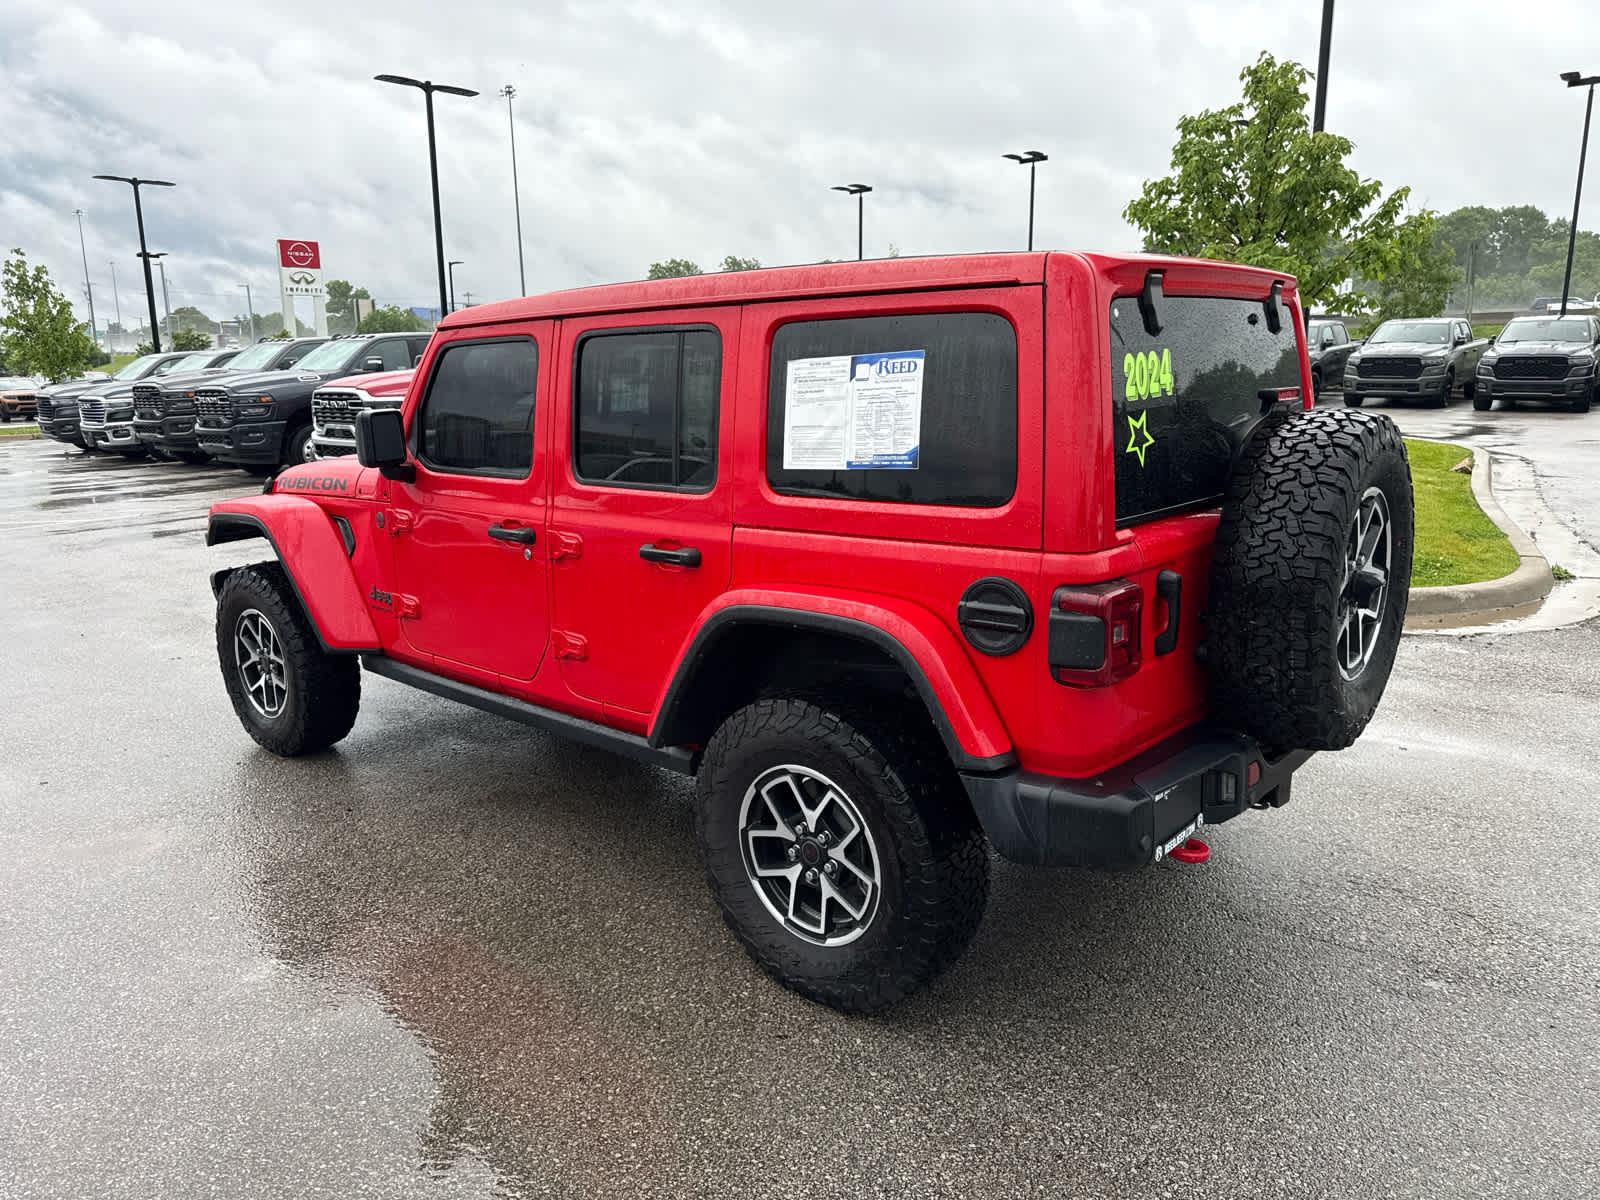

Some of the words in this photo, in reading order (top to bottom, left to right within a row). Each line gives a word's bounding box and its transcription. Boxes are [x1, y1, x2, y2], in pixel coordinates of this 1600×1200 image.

[878, 359, 918, 374] REED
[1123, 348, 1174, 401] 2024
[320, 400, 348, 408] RAM
[277, 476, 347, 491] RUBICON
[369, 584, 393, 606] Jeep
